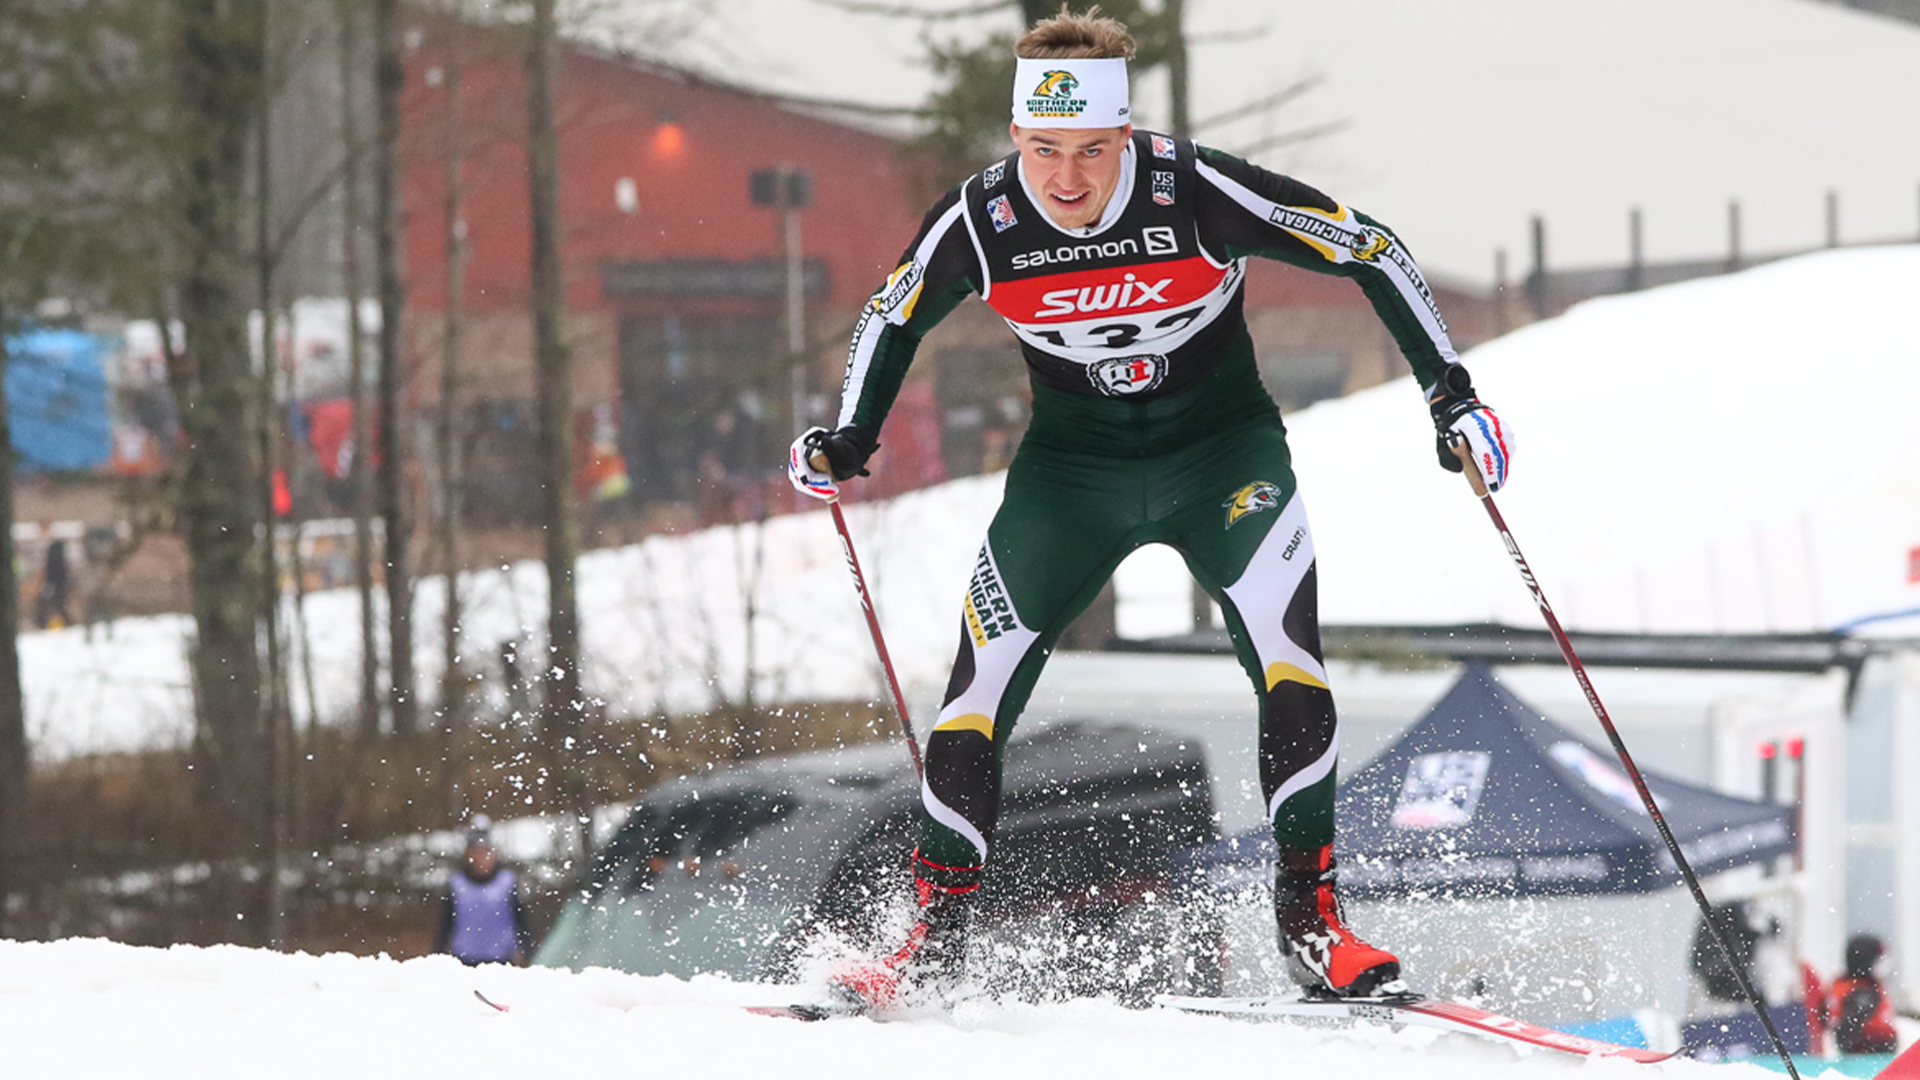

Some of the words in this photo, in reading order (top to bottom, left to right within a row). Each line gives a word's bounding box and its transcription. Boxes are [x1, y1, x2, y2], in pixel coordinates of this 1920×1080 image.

[1153, 173, 1173, 185] US
[1270, 207, 1355, 247] MICHIGAN
[1282, 529, 1304, 561] CRAFT
